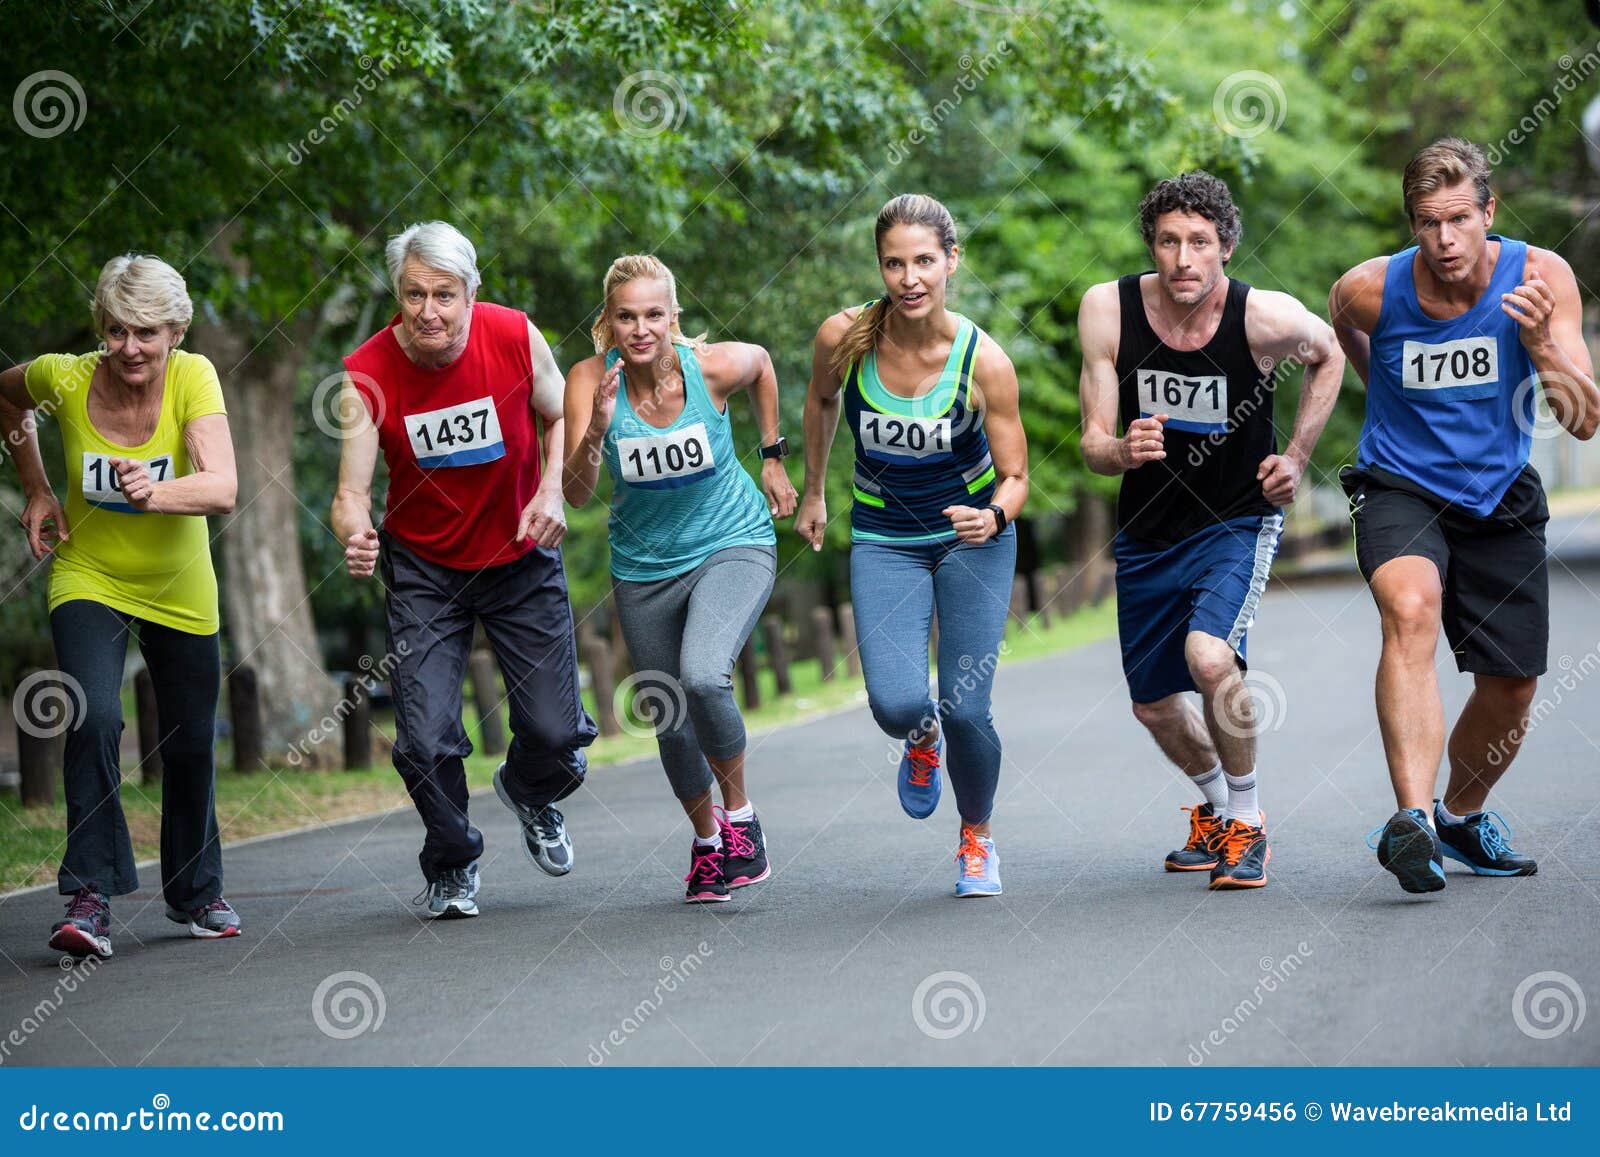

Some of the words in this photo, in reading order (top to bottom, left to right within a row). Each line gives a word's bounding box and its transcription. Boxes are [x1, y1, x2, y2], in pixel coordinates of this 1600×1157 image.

[1411, 347, 1490, 382] 1708
[1144, 374, 1219, 410] 1671
[416, 408, 489, 451] 1437
[866, 417, 943, 451] 1201
[628, 437, 704, 477] 1109
